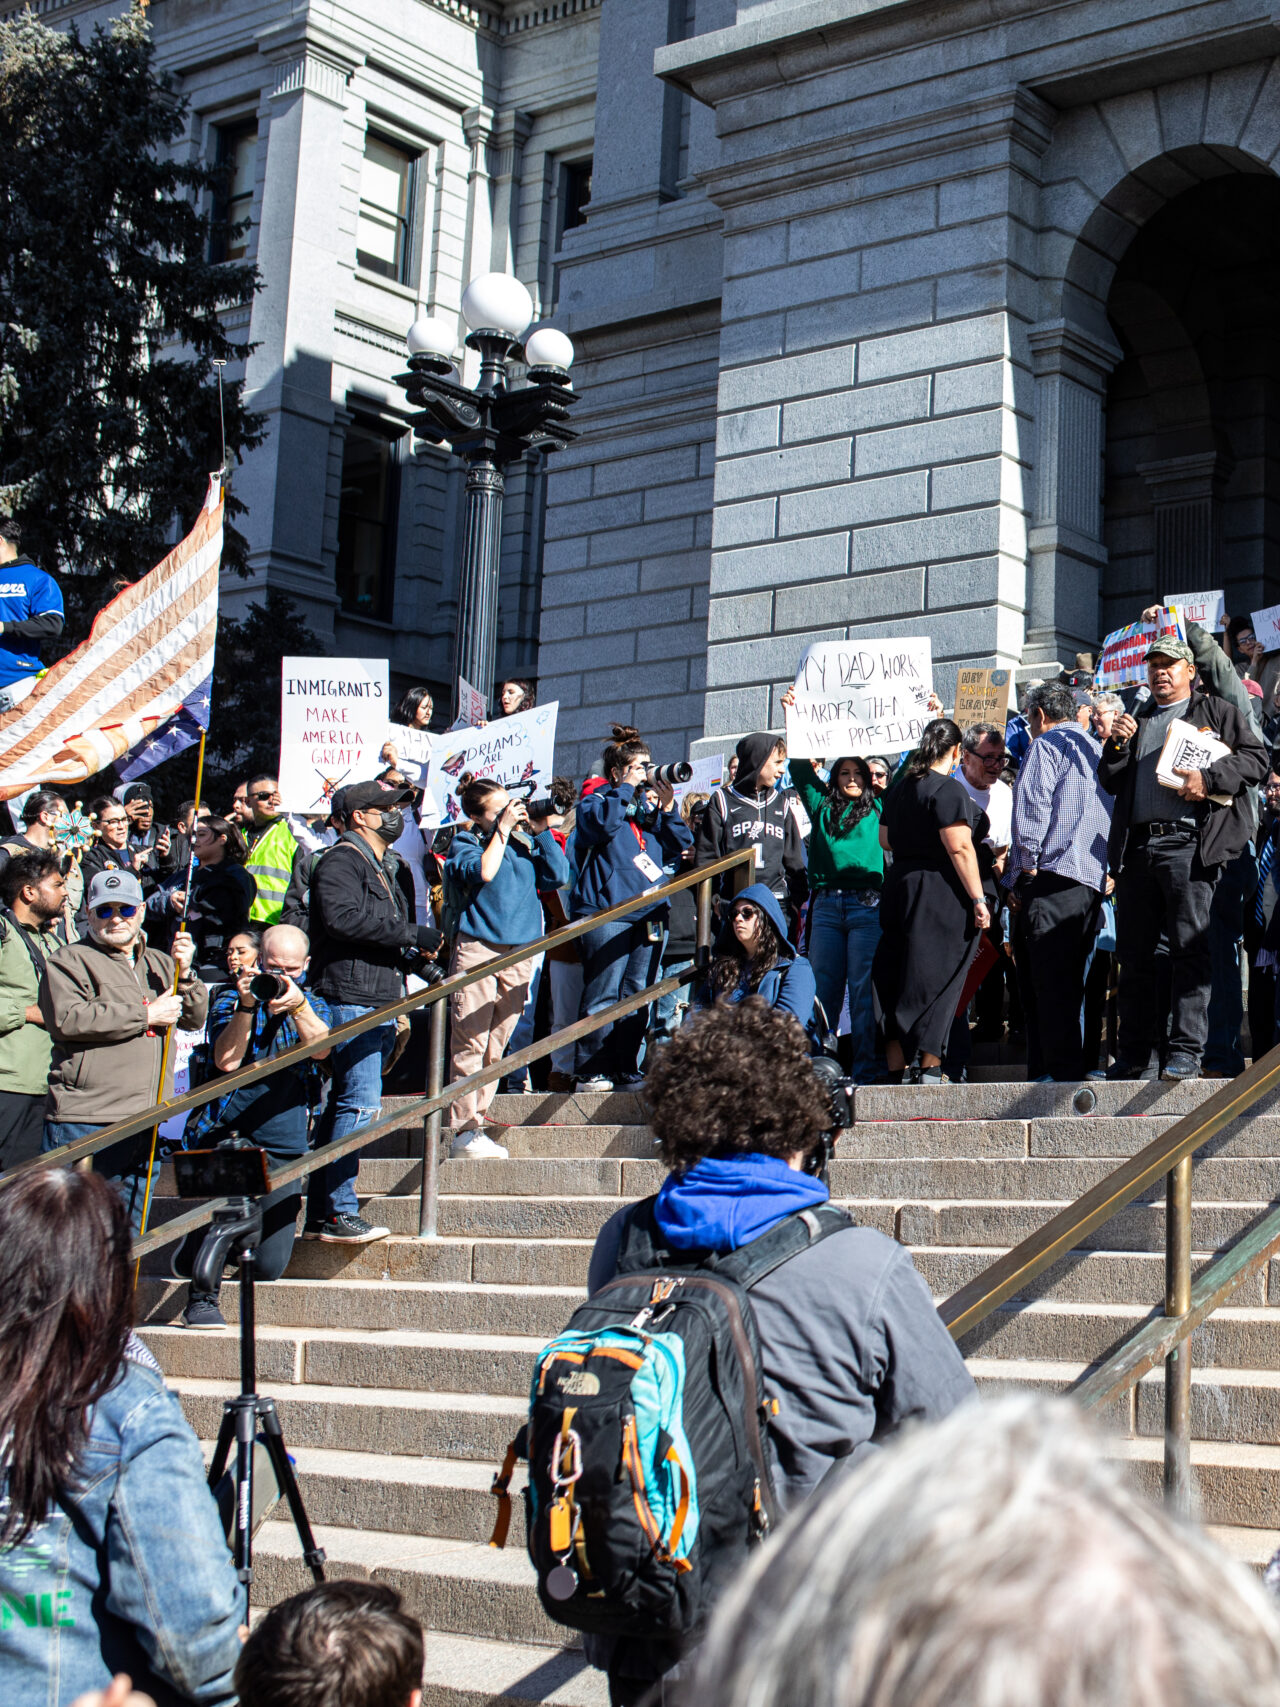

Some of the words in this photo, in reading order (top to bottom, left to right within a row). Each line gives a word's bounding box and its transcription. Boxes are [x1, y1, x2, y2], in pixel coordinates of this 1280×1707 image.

[1184, 605, 1206, 620] UILT
[1104, 630, 1158, 657] IMMIGRANTS
[1160, 624, 1177, 638] ARE
[838, 652, 875, 684] DAD
[1103, 652, 1147, 674] WELCOME
[961, 671, 983, 684] HEY
[306, 707, 350, 724] MAKE
[795, 699, 857, 724] HARDER
[302, 729, 364, 745] AMERICA
[466, 732, 522, 763] DREAMS
[311, 749, 361, 766] GREAT!
[483, 753, 503, 766] ARE
[472, 763, 496, 780] NOT
